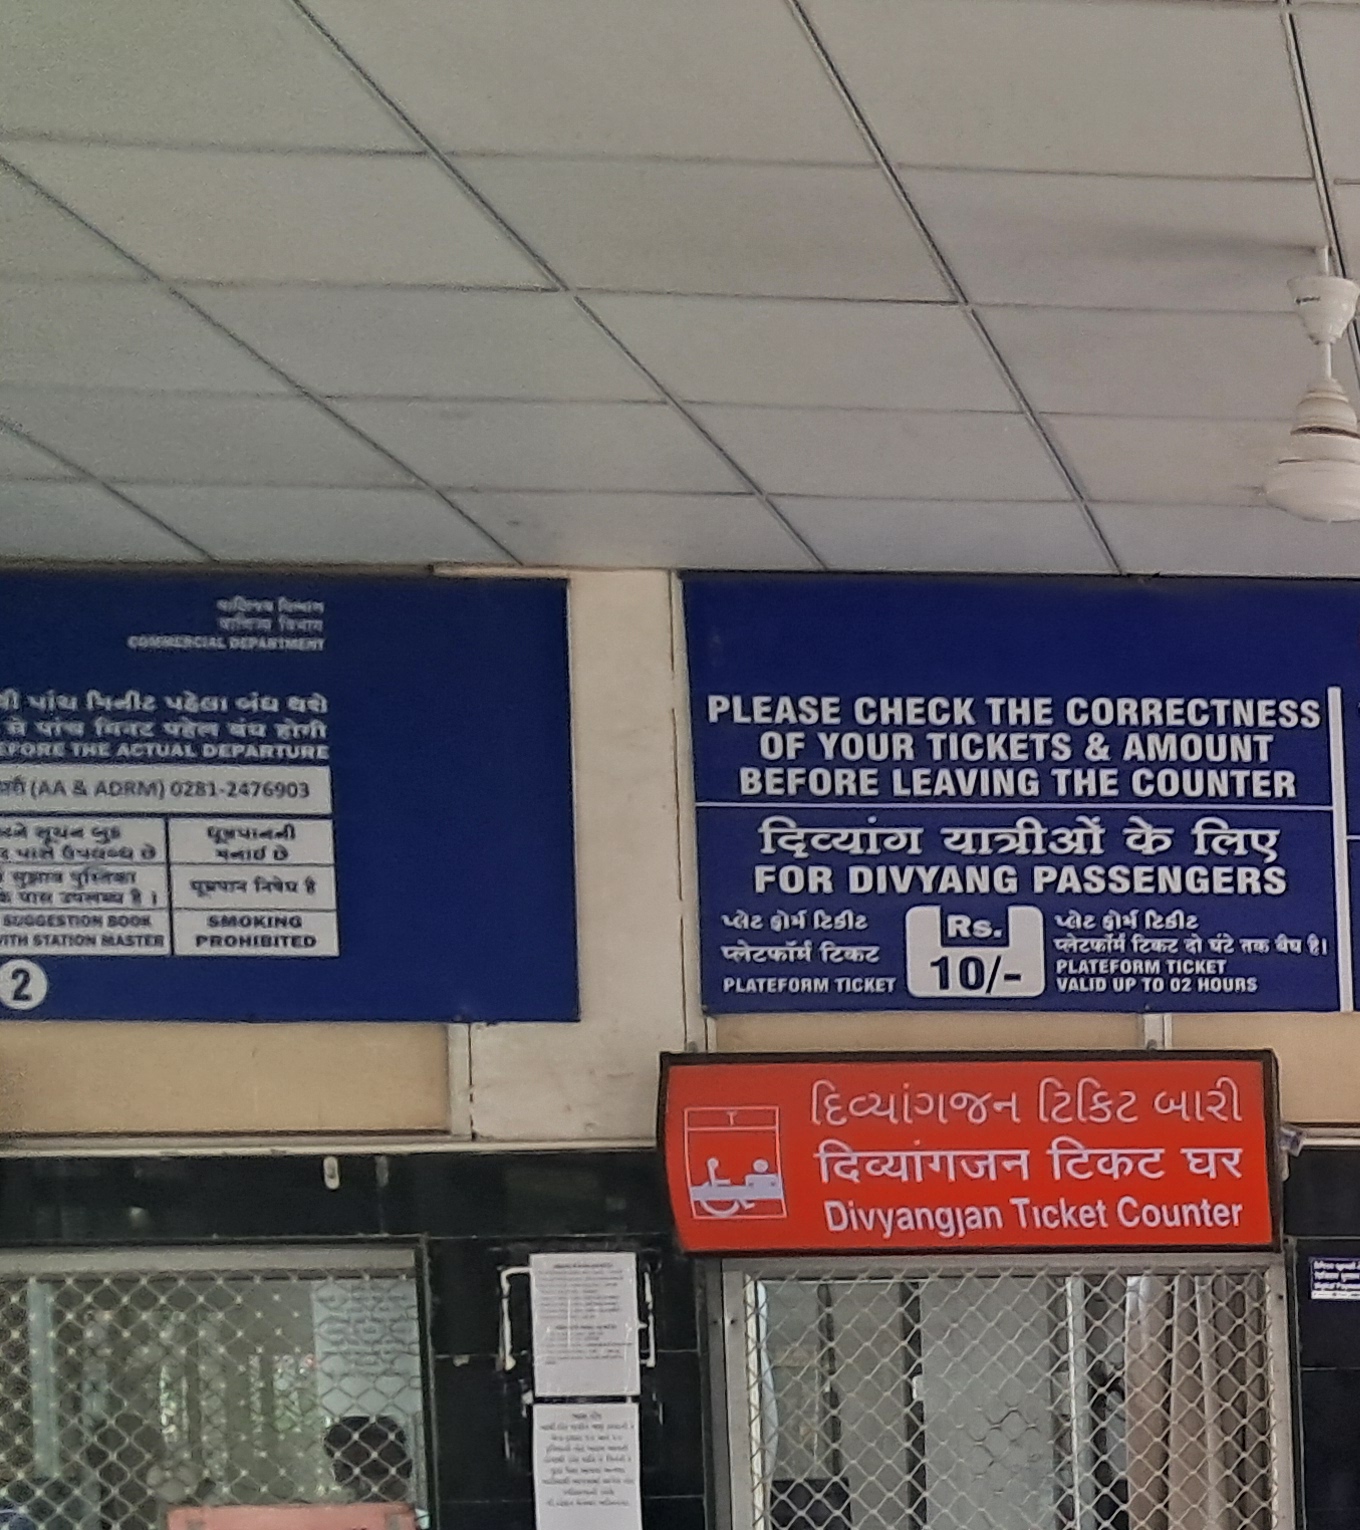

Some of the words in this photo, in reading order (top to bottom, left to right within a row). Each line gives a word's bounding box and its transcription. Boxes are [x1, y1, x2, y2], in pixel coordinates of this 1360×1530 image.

[708, 694, 841, 725] PLEASE
[854, 696, 976, 726] CHECK
[984, 697, 1054, 726] THE
[1066, 697, 1321, 729] CORRECTNESS
[71, 742, 110, 757] THE
[116, 742, 197, 758] ACTUAL
[202, 742, 330, 760] DEPARTURE
[760, 730, 806, 761] OF
[817, 731, 915, 762] YOUR
[925, 732, 1072, 762] TICKETS
[1084, 732, 1111, 762] &
[1122, 732, 1274, 764] AMOUNT
[30, 779, 67, 801] (AA
[72, 780, 88, 796] &
[93, 778, 166, 801] ADRM)
[169, 780, 310, 799] 0281-2476903
[739, 766, 879, 797] BEFORE
[892, 767, 1040, 797] LEAVING
[1050, 768, 1120, 797] THE
[1131, 767, 1297, 798] COUNTER
[757, 815, 925, 859] दिव्यांग
[940, 815, 1106, 855] यात्रीओं
[1122, 815, 1175, 855] के
[1190, 816, 1281, 864] लिए
[754, 864, 834, 894] FOR
[848, 864, 1018, 894] DIVYANG
[1033, 864, 1287, 895] PASSENGERS
[208, 914, 303, 929] SMOKING
[947, 914, 1003, 938] Rs.
[195, 934, 317, 948] PROHIBITED
[11, 967, 32, 1002] 2
[723, 977, 829, 993] PLATEFORM
[834, 977, 897, 993] TICKET
[930, 954, 1022, 995] 10/-
[1056, 976, 1107, 992] VALID
[1112, 976, 1137, 992] UP
[1140, 976, 1165, 993] TO
[1169, 977, 1192, 993] 02
[1197, 976, 1258, 993] HOURS
[811, 1079, 1021, 1126] દિવ્યાંગજન
[1039, 1077, 1138, 1124] ટિકિટ
[1154, 1076, 1243, 1122] બારી
[813, 1138, 1031, 1184] दिव्यांगजन
[1045, 1135, 1166, 1181] टिकट
[1179, 1147, 1244, 1179] घर
[823, 1200, 1003, 1239] Divyangjan
[1009, 1197, 1109, 1229] Ticket
[1122, 1197, 1243, 1228] Counter
